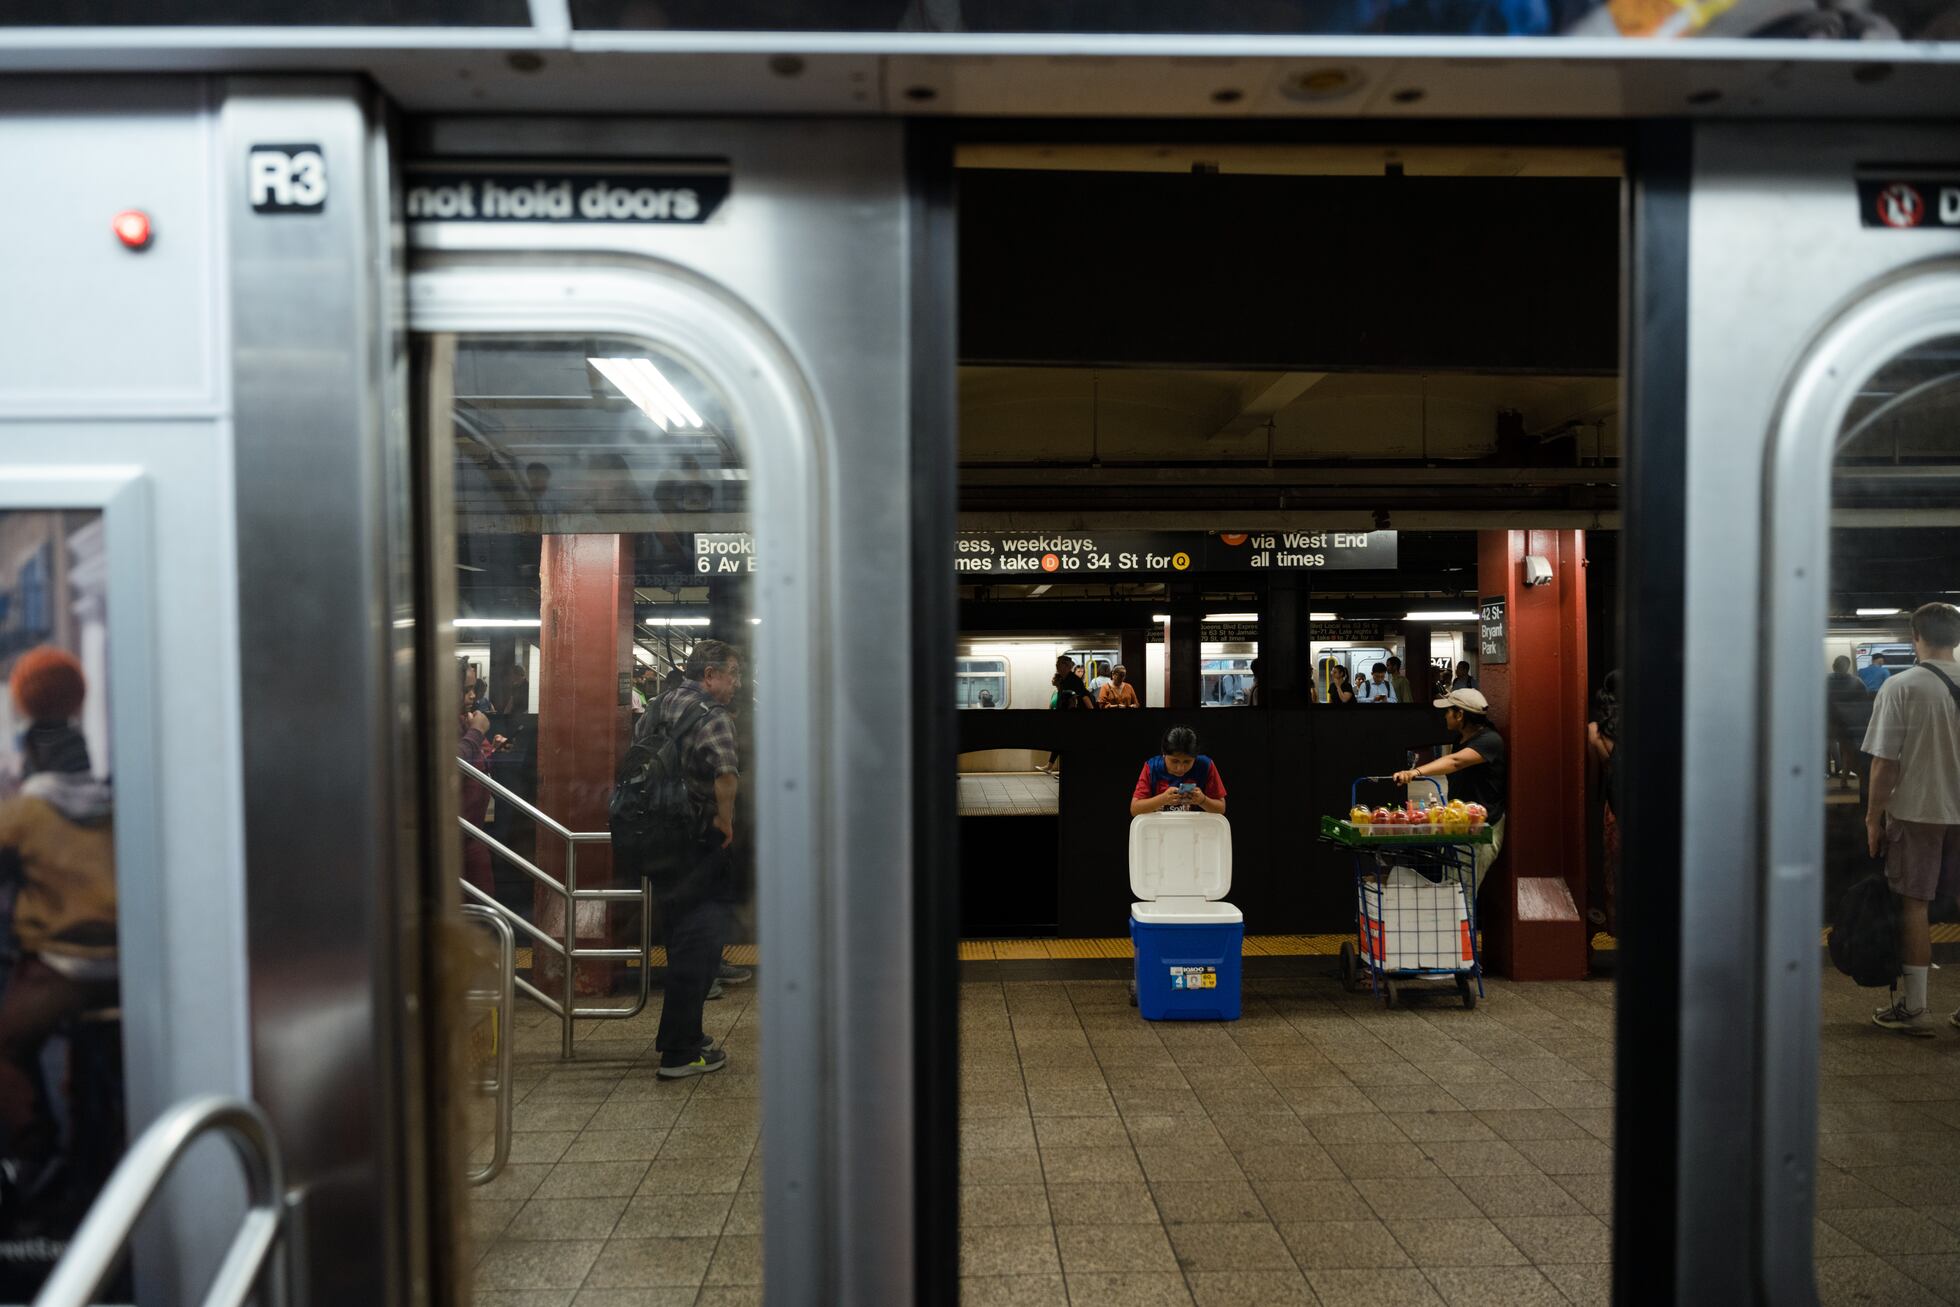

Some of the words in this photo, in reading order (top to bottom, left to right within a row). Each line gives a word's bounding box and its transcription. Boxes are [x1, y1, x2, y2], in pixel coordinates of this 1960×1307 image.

[249, 150, 327, 205] R3
[407, 184, 475, 218] not
[483, 181, 572, 219] hold
[581, 181, 700, 219] doors
[1003, 536, 1098, 554] weekdays.
[1250, 534, 1276, 549] via
[1282, 533, 1328, 549] West
[1334, 533, 1368, 548] End
[697, 556, 711, 573] 6
[717, 556, 740, 573] Av
[1000, 554, 1040, 570] take
[1062, 555, 1080, 570] to
[1086, 553, 1112, 569] 34
[1118, 552, 1139, 569] St
[1146, 552, 1171, 569] for
[1250, 551, 1270, 567] all
[1276, 551, 1325, 567] times
[1481, 607, 1491, 621] 42
[1481, 623, 1503, 640] Bryant
[1481, 641, 1497, 655] Park
